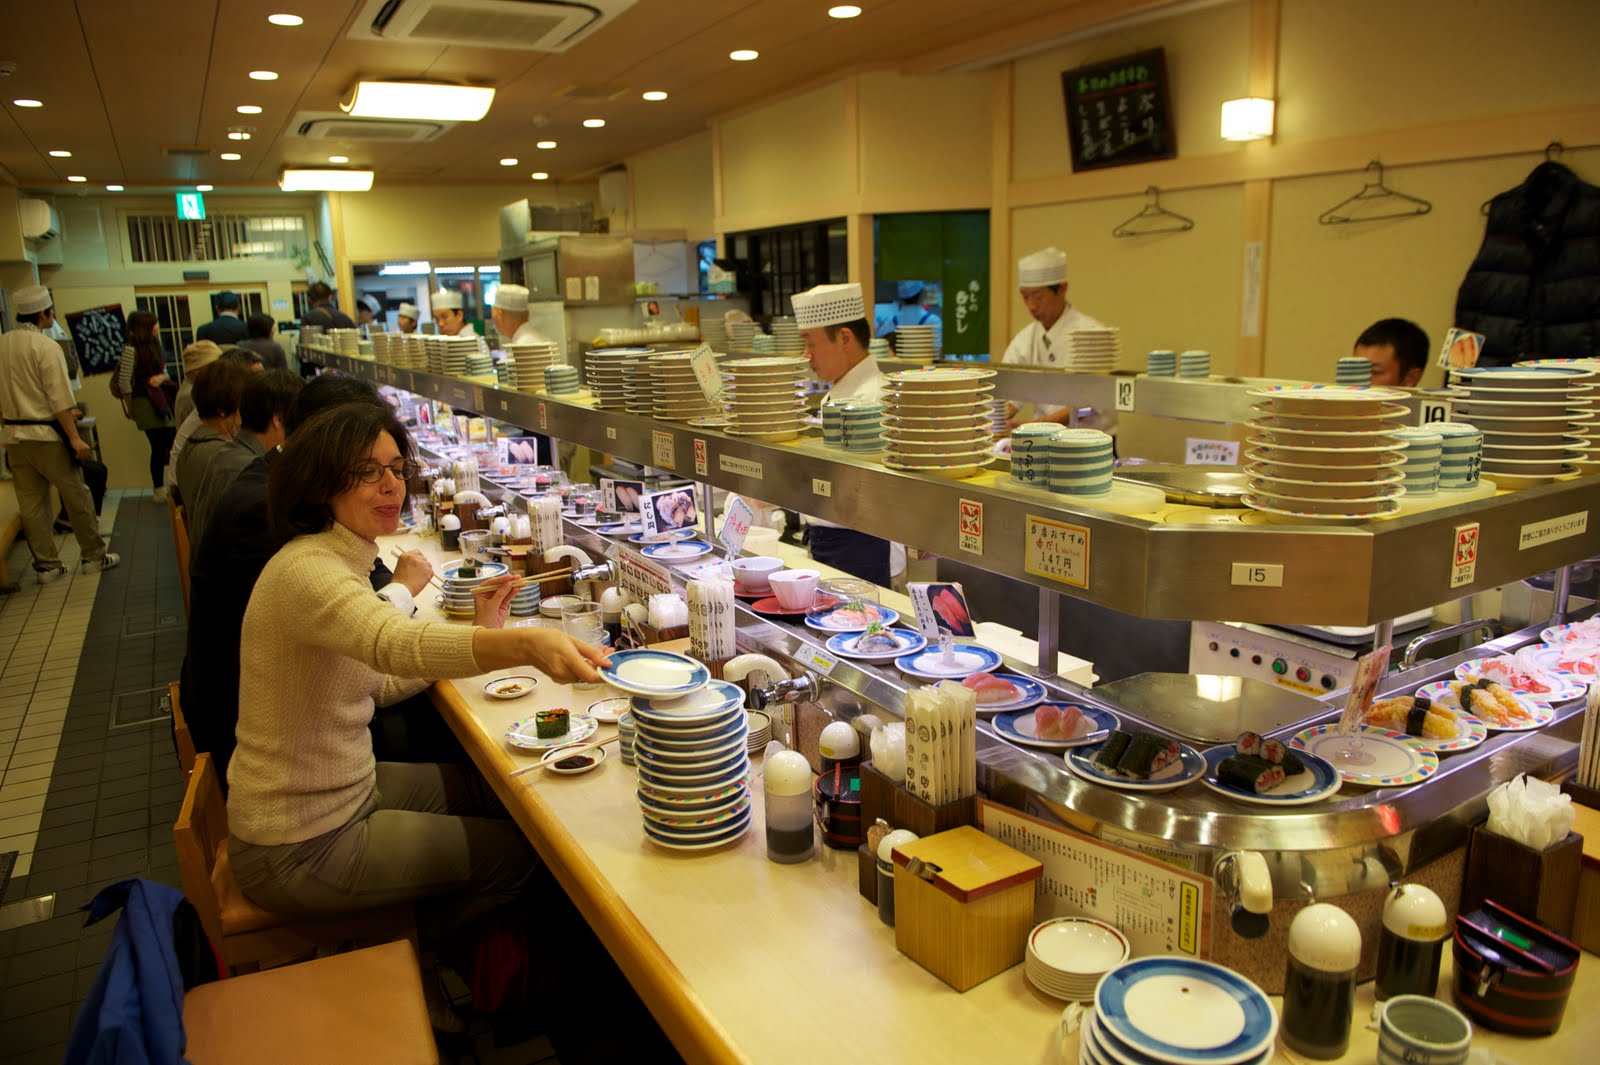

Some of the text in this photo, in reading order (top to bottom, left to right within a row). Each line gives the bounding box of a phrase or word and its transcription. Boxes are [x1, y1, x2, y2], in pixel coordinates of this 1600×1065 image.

[817, 483, 825, 493] 14
[1041, 551, 1072, 570] 147円
[1249, 567, 1266, 583] 15
